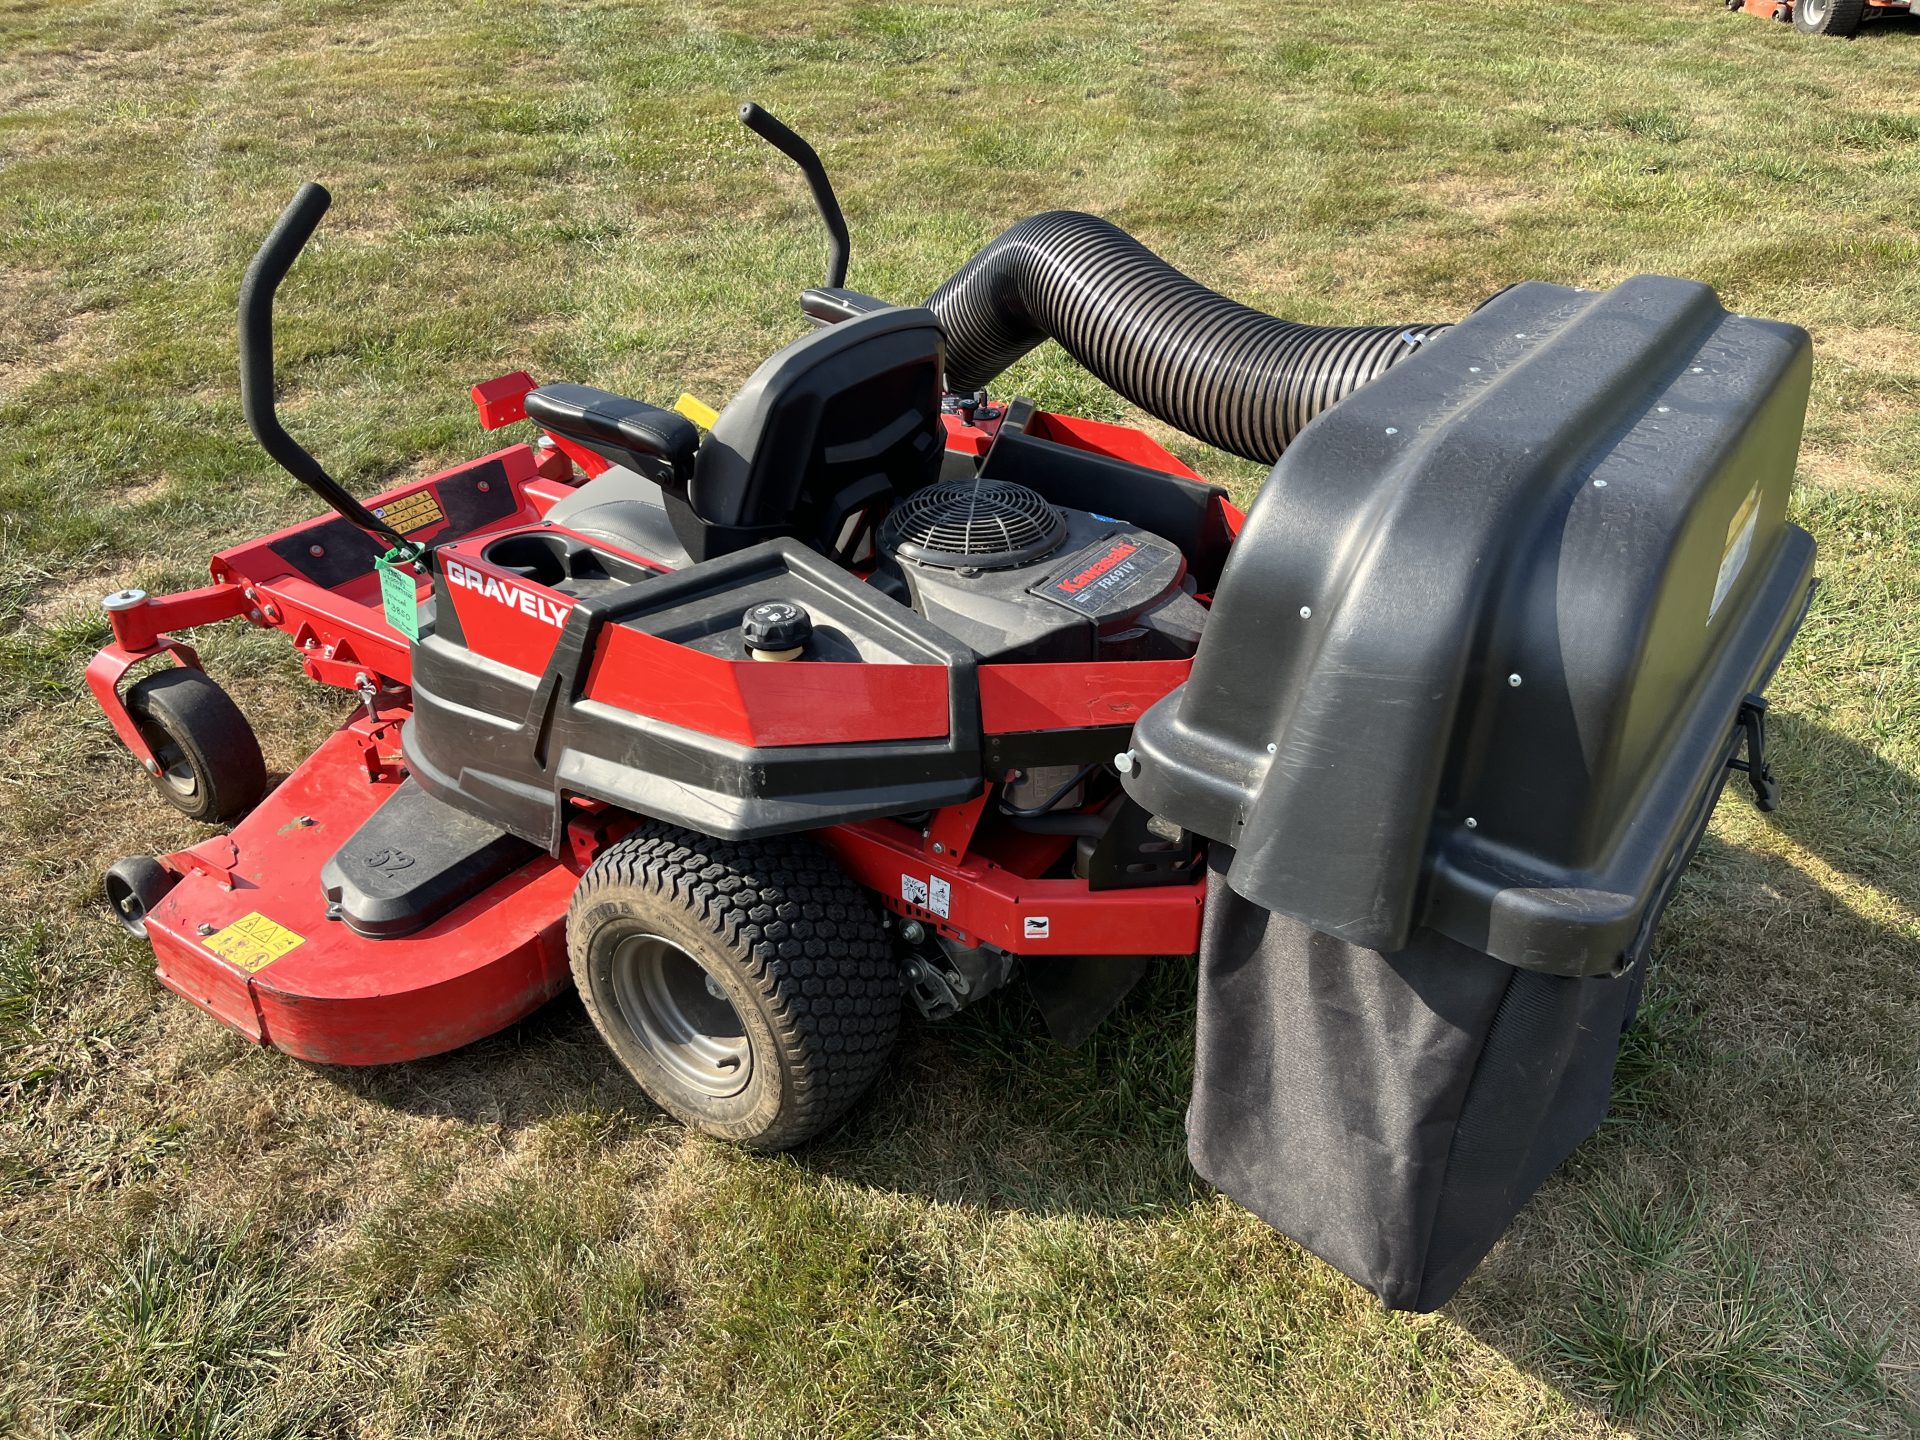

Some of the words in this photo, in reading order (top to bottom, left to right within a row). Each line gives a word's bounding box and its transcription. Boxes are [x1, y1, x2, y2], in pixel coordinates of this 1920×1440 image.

[1056, 541, 1137, 593] Kawasaki
[1099, 562, 1135, 590] FR691V
[446, 559, 568, 628] GRAVELY
[364, 847, 416, 878] 52
[579, 901, 635, 939] KENDA
